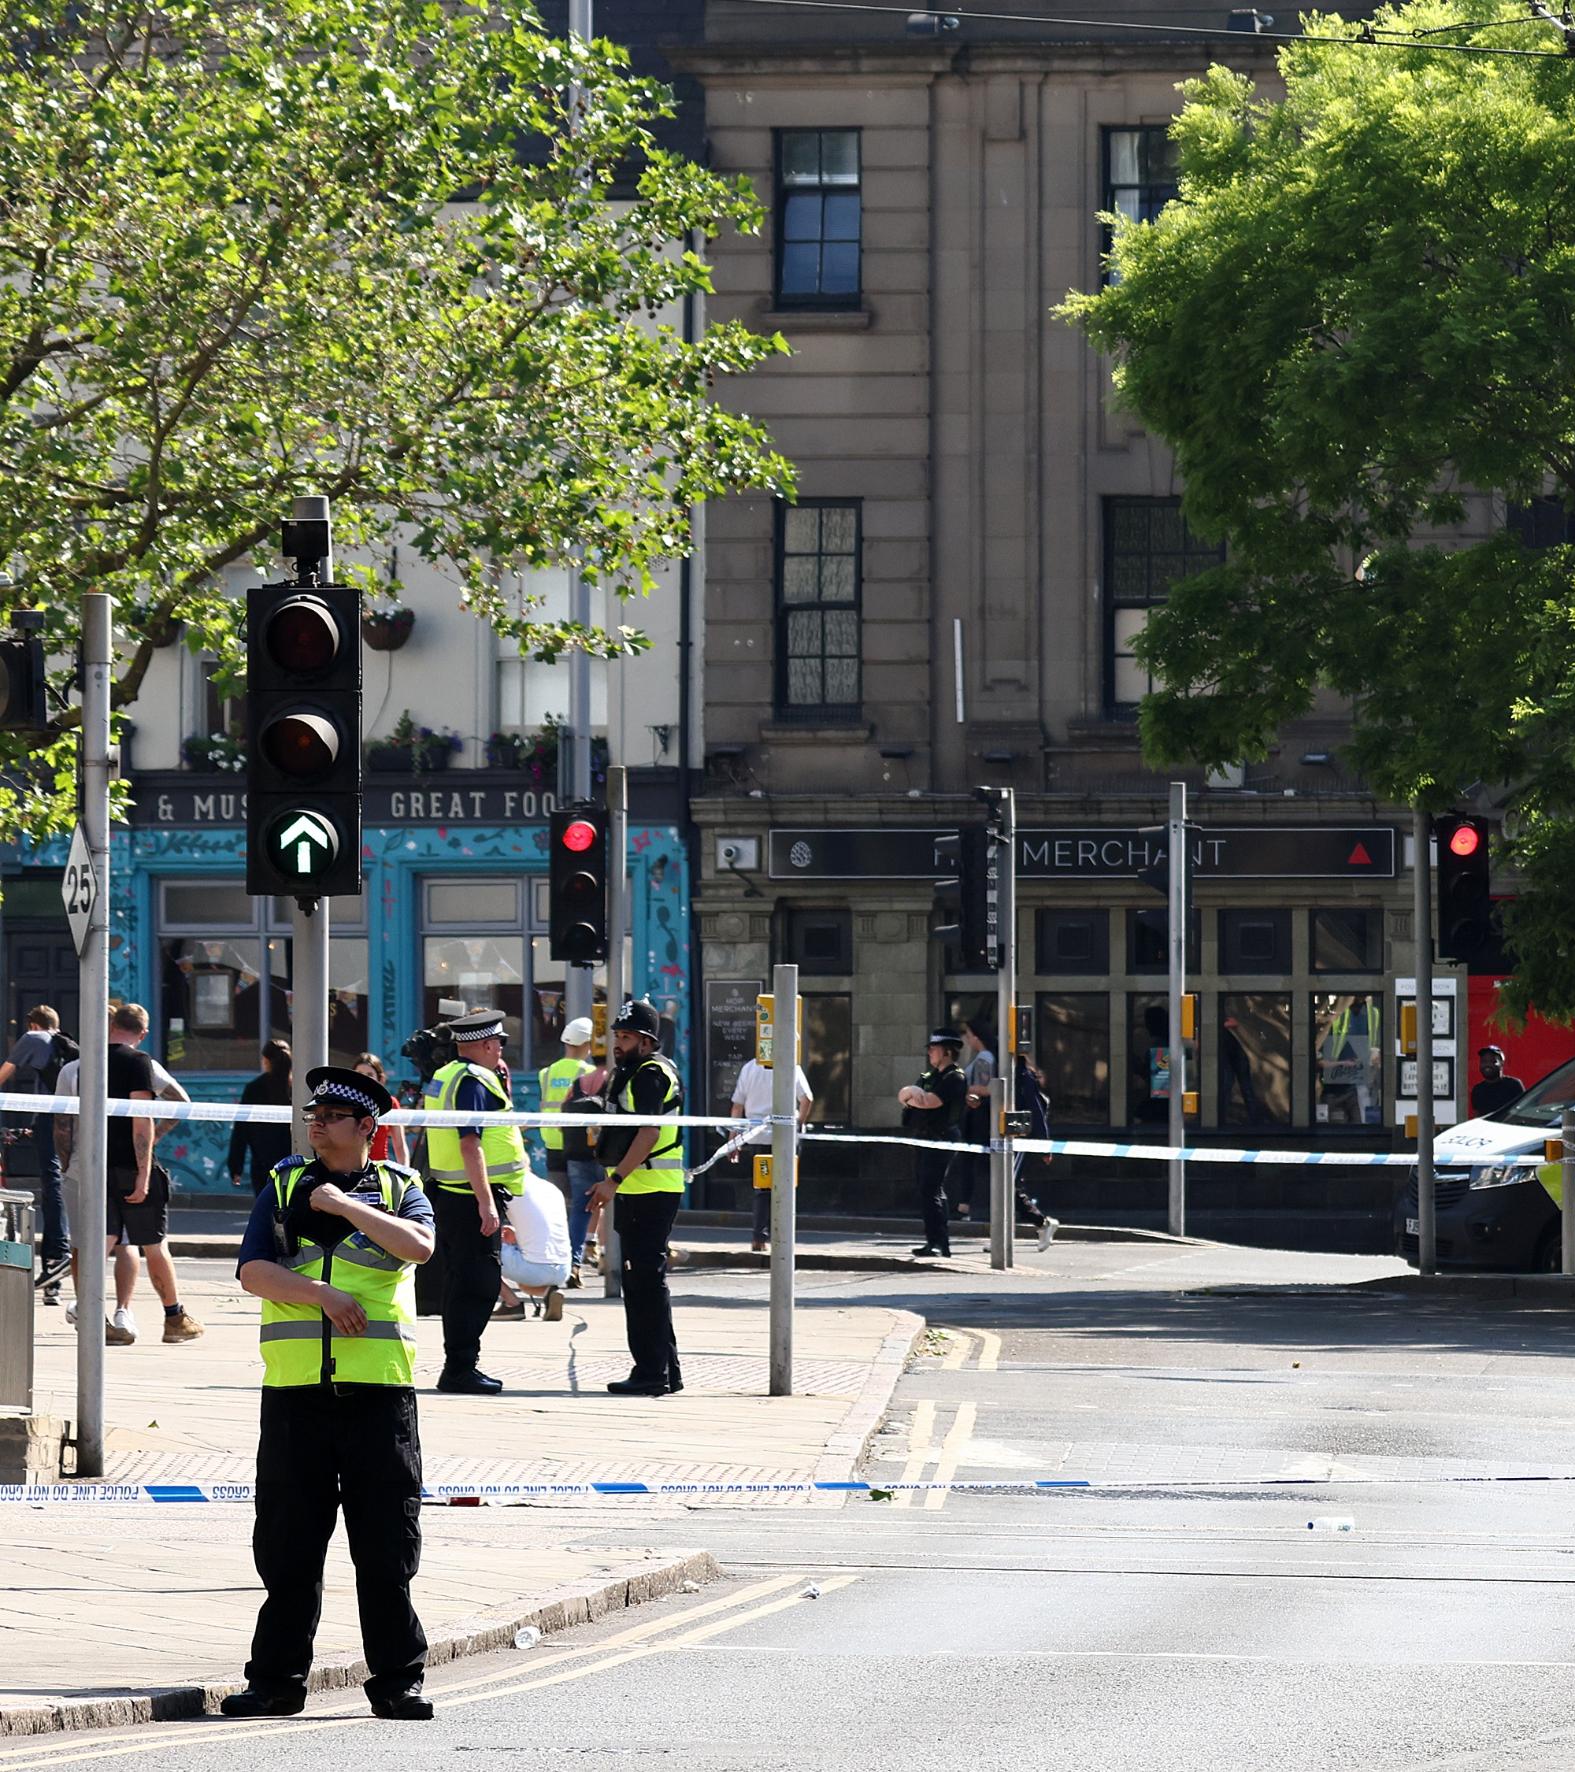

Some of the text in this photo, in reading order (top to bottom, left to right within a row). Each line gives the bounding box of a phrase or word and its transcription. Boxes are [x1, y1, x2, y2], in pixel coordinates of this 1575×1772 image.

[158, 795, 175, 820] &
[390, 791, 487, 818] GREAT
[67, 864, 91, 915] 25
[26, 1486, 50, 1500] NOT
[53, 1486, 68, 1500] DO
[72, 1486, 97, 1500] LINE
[100, 1486, 139, 1500] POLICE
[212, 1486, 250, 1499] CROSS
